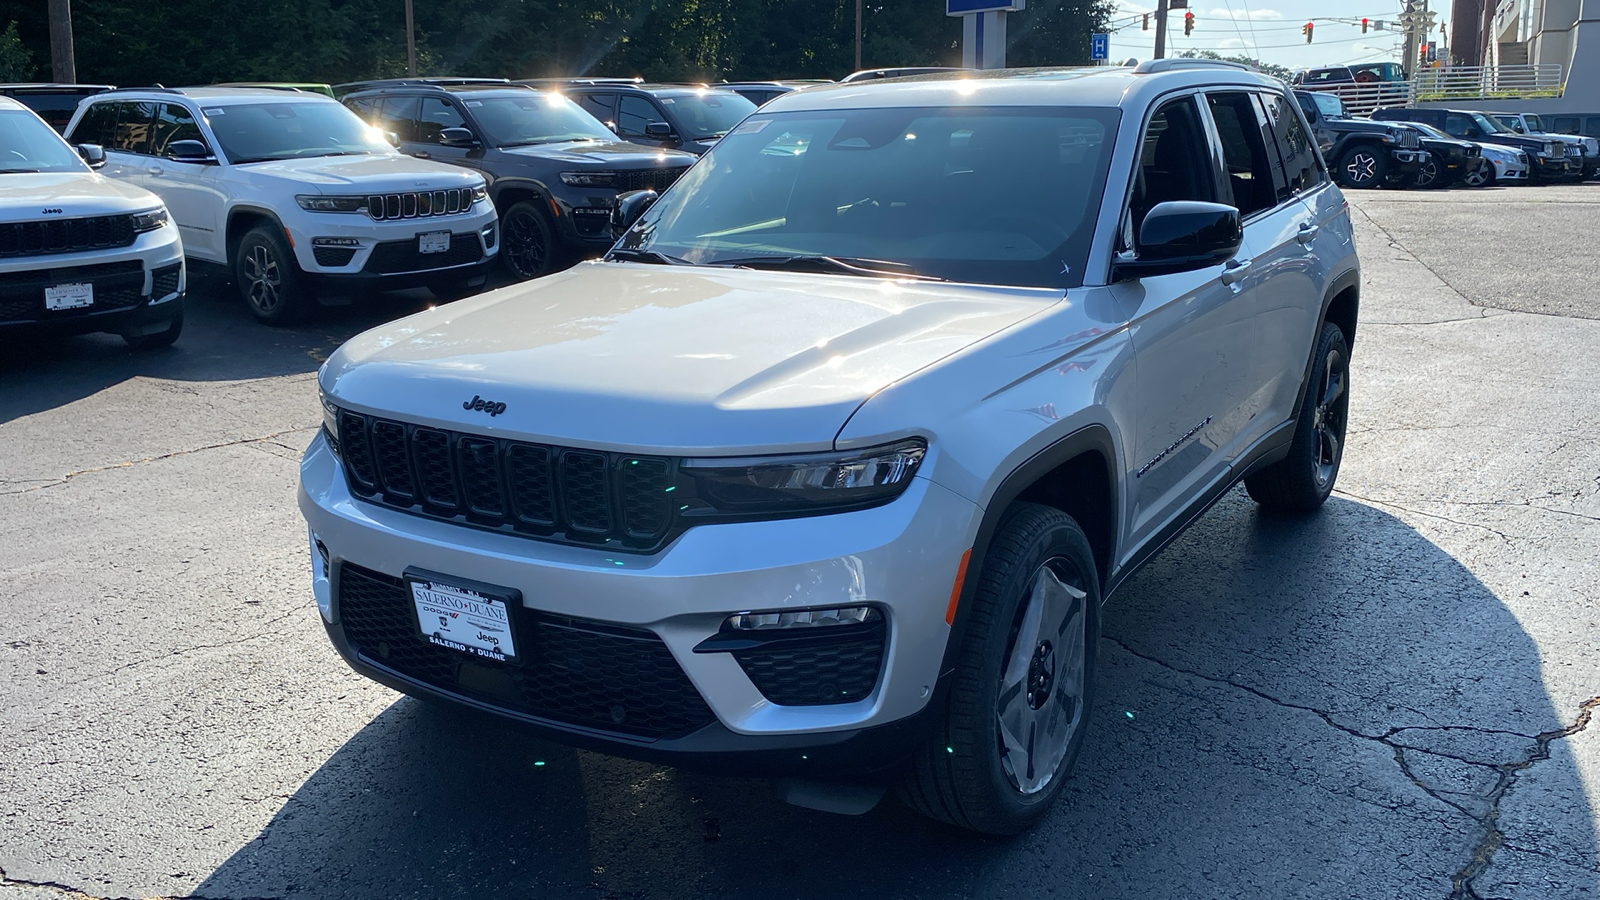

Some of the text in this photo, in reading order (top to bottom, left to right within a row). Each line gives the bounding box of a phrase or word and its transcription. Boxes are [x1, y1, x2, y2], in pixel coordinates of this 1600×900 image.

[1095, 39, 1104, 52] H
[462, 394, 507, 417] Jeep
[415, 590, 507, 621] SALERNO DUANE
[429, 636, 506, 662] SALERNO DUANE
[476, 631, 499, 646] Jeep
